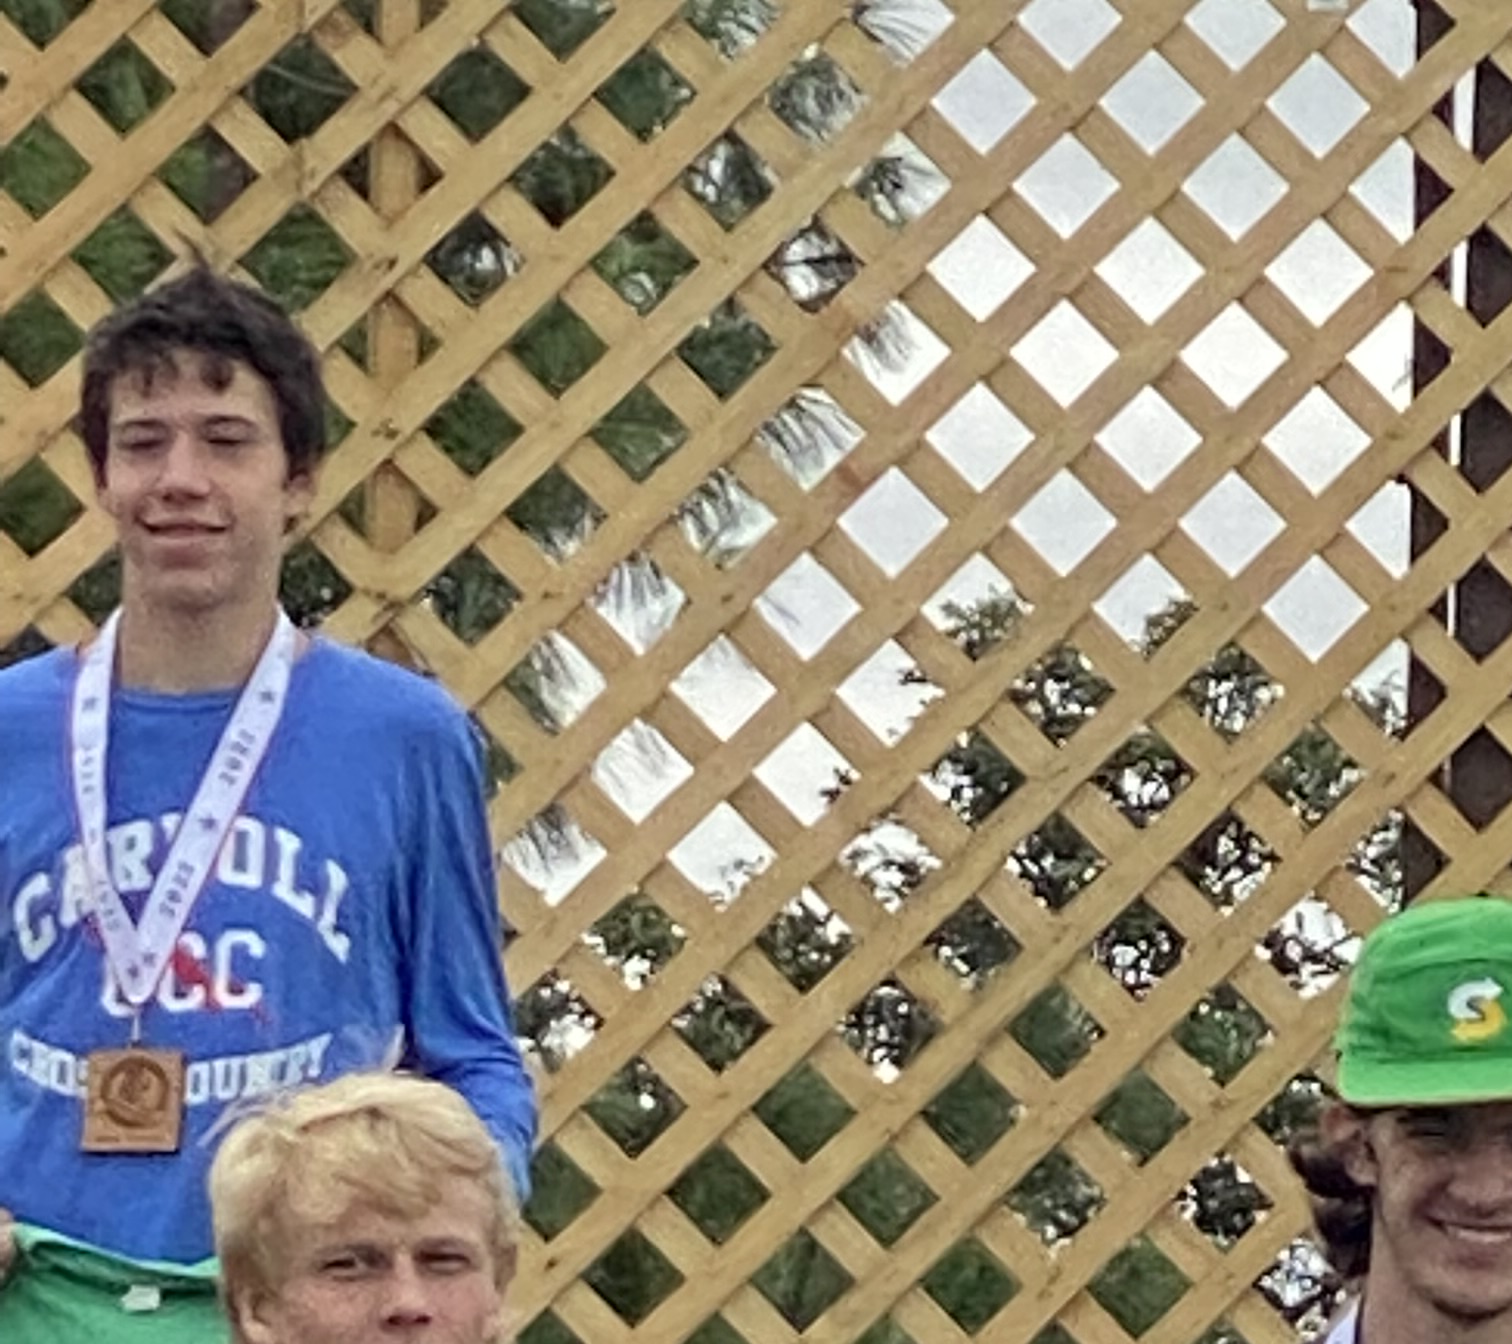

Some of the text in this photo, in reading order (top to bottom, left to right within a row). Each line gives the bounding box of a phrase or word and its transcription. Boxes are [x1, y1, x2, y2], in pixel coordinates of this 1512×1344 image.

[13, 812, 351, 964] CAROLL
[10, 1029, 333, 1106] CRO OUNTRY
